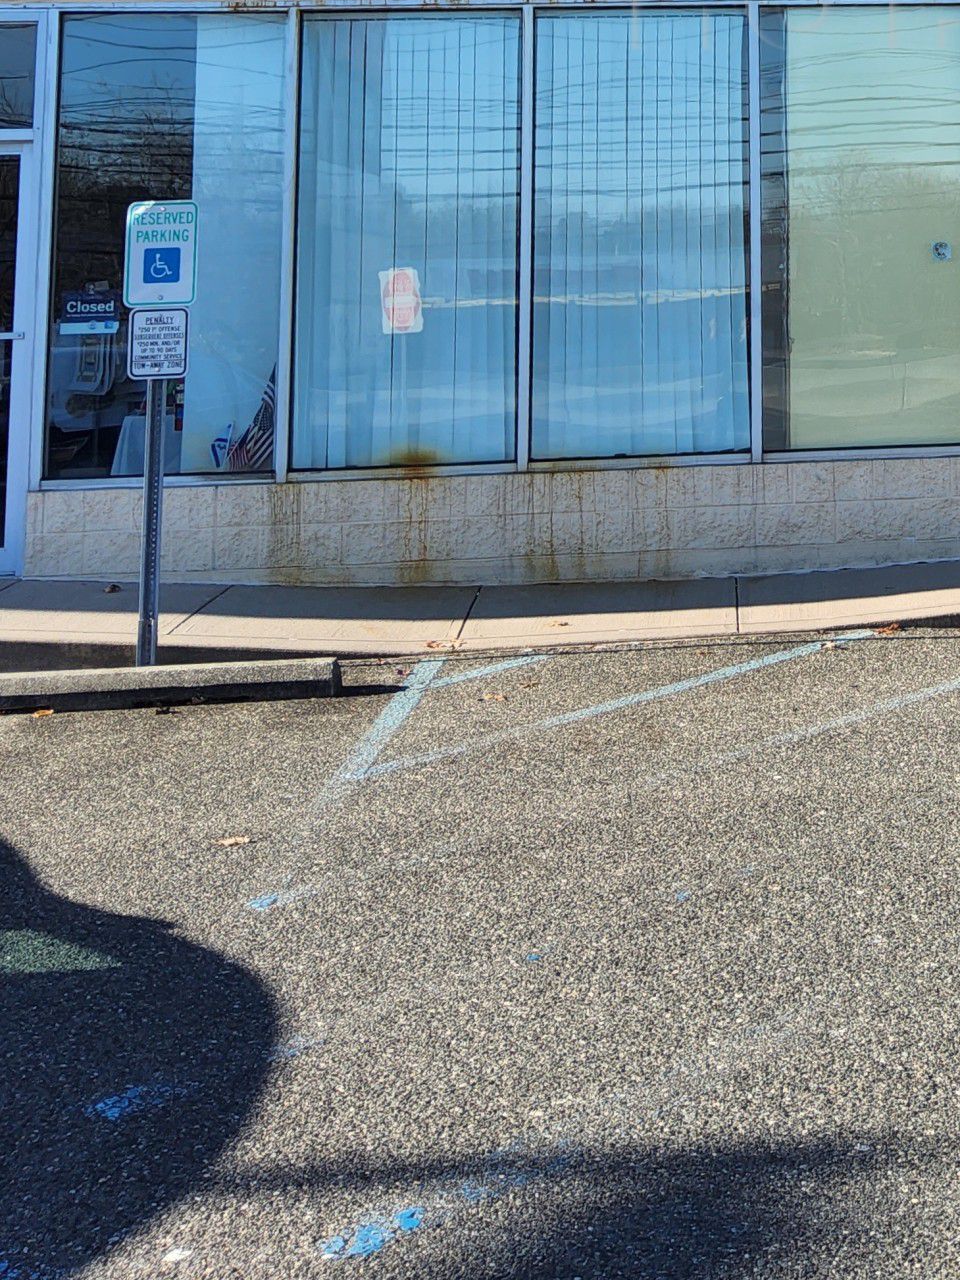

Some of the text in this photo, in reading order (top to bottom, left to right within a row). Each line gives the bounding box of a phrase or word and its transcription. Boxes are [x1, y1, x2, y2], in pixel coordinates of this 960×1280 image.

[132, 211, 194, 226] RESERVED
[136, 228, 190, 244] PARKING
[66, 299, 115, 313] Closed
[145, 316, 175, 325] PENALTY
